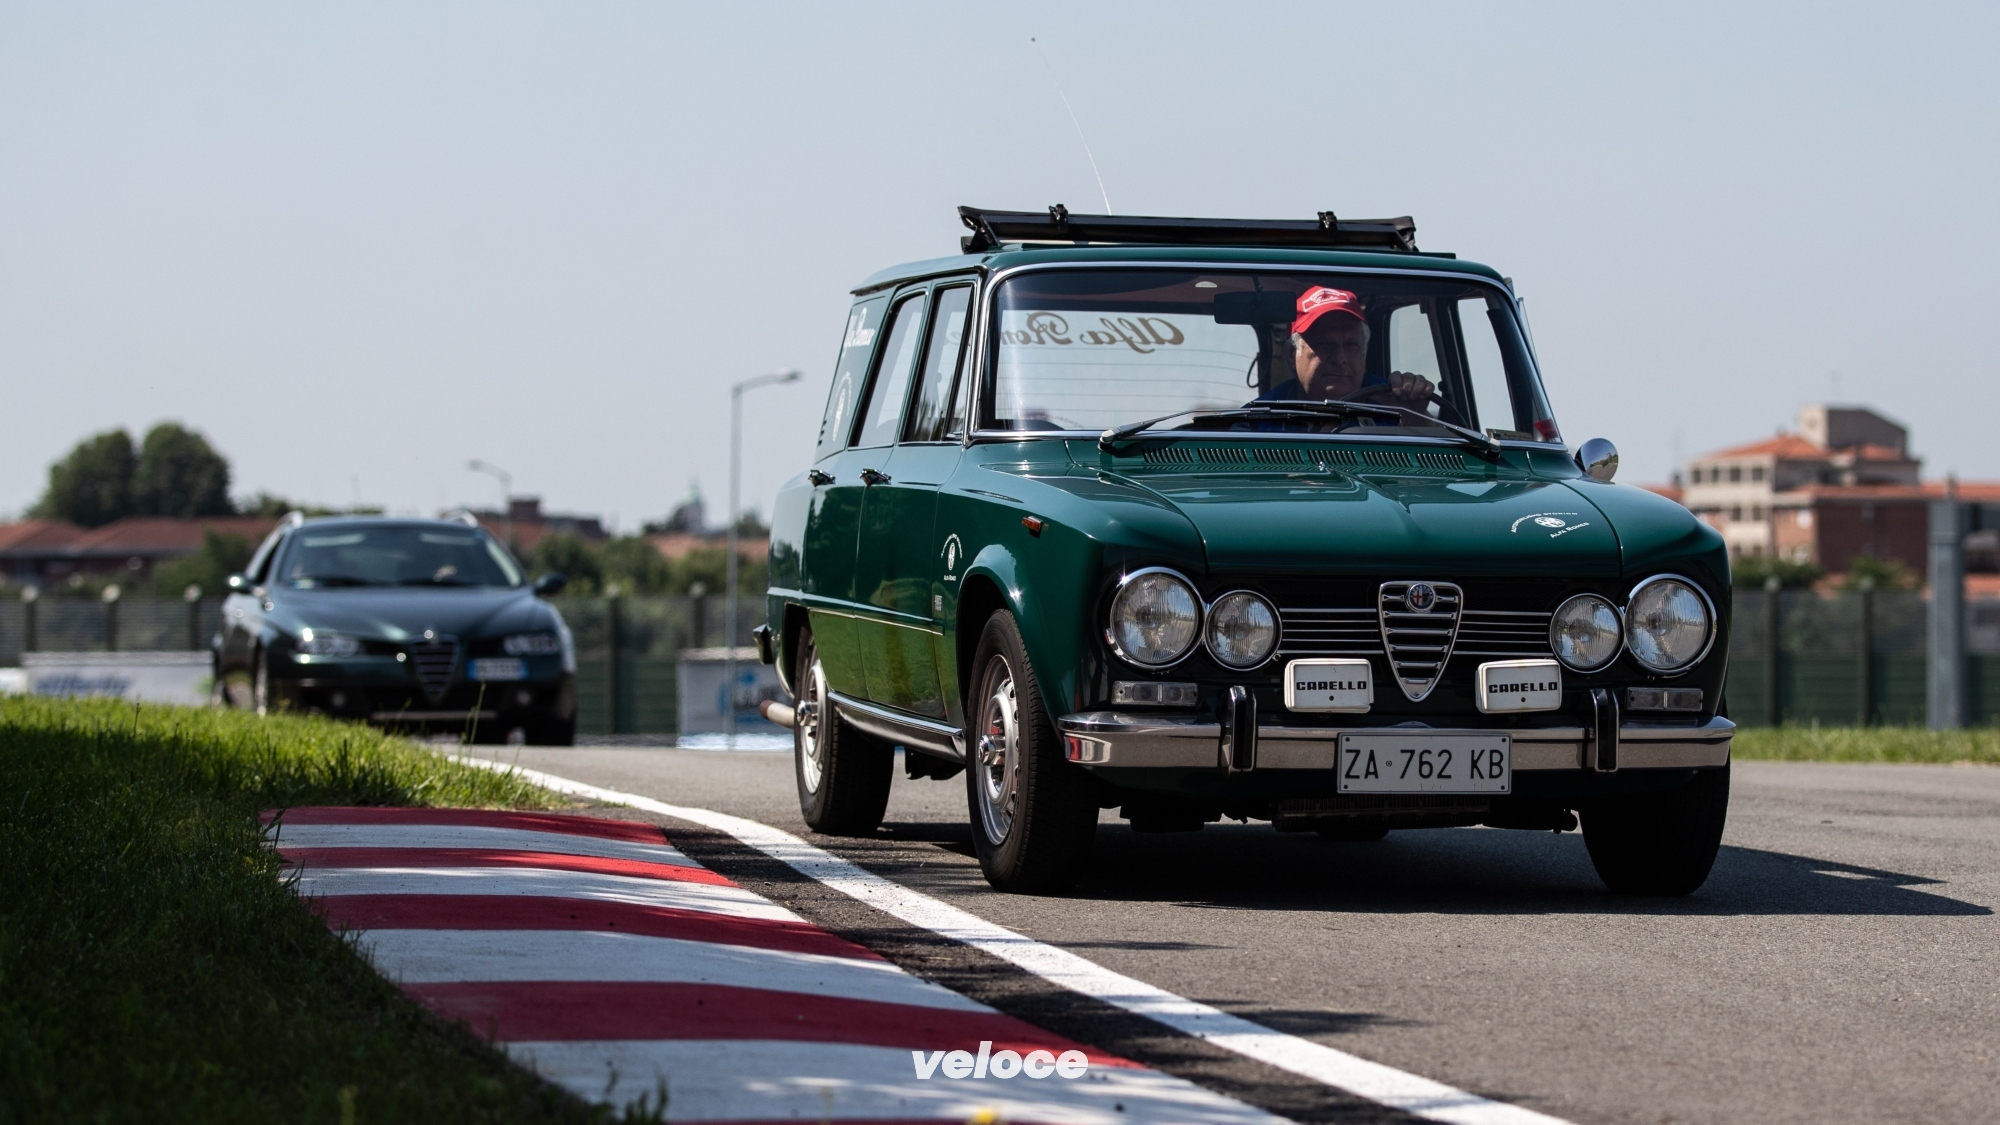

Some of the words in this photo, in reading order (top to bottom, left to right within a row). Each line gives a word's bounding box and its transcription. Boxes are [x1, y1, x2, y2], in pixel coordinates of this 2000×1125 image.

[1296, 680, 1368, 691] CARELLO
[1488, 681, 1558, 693] CARELLO
[1344, 748, 1379, 779] ZA
[1399, 748, 1453, 780] 762
[1470, 748, 1504, 779] KB
